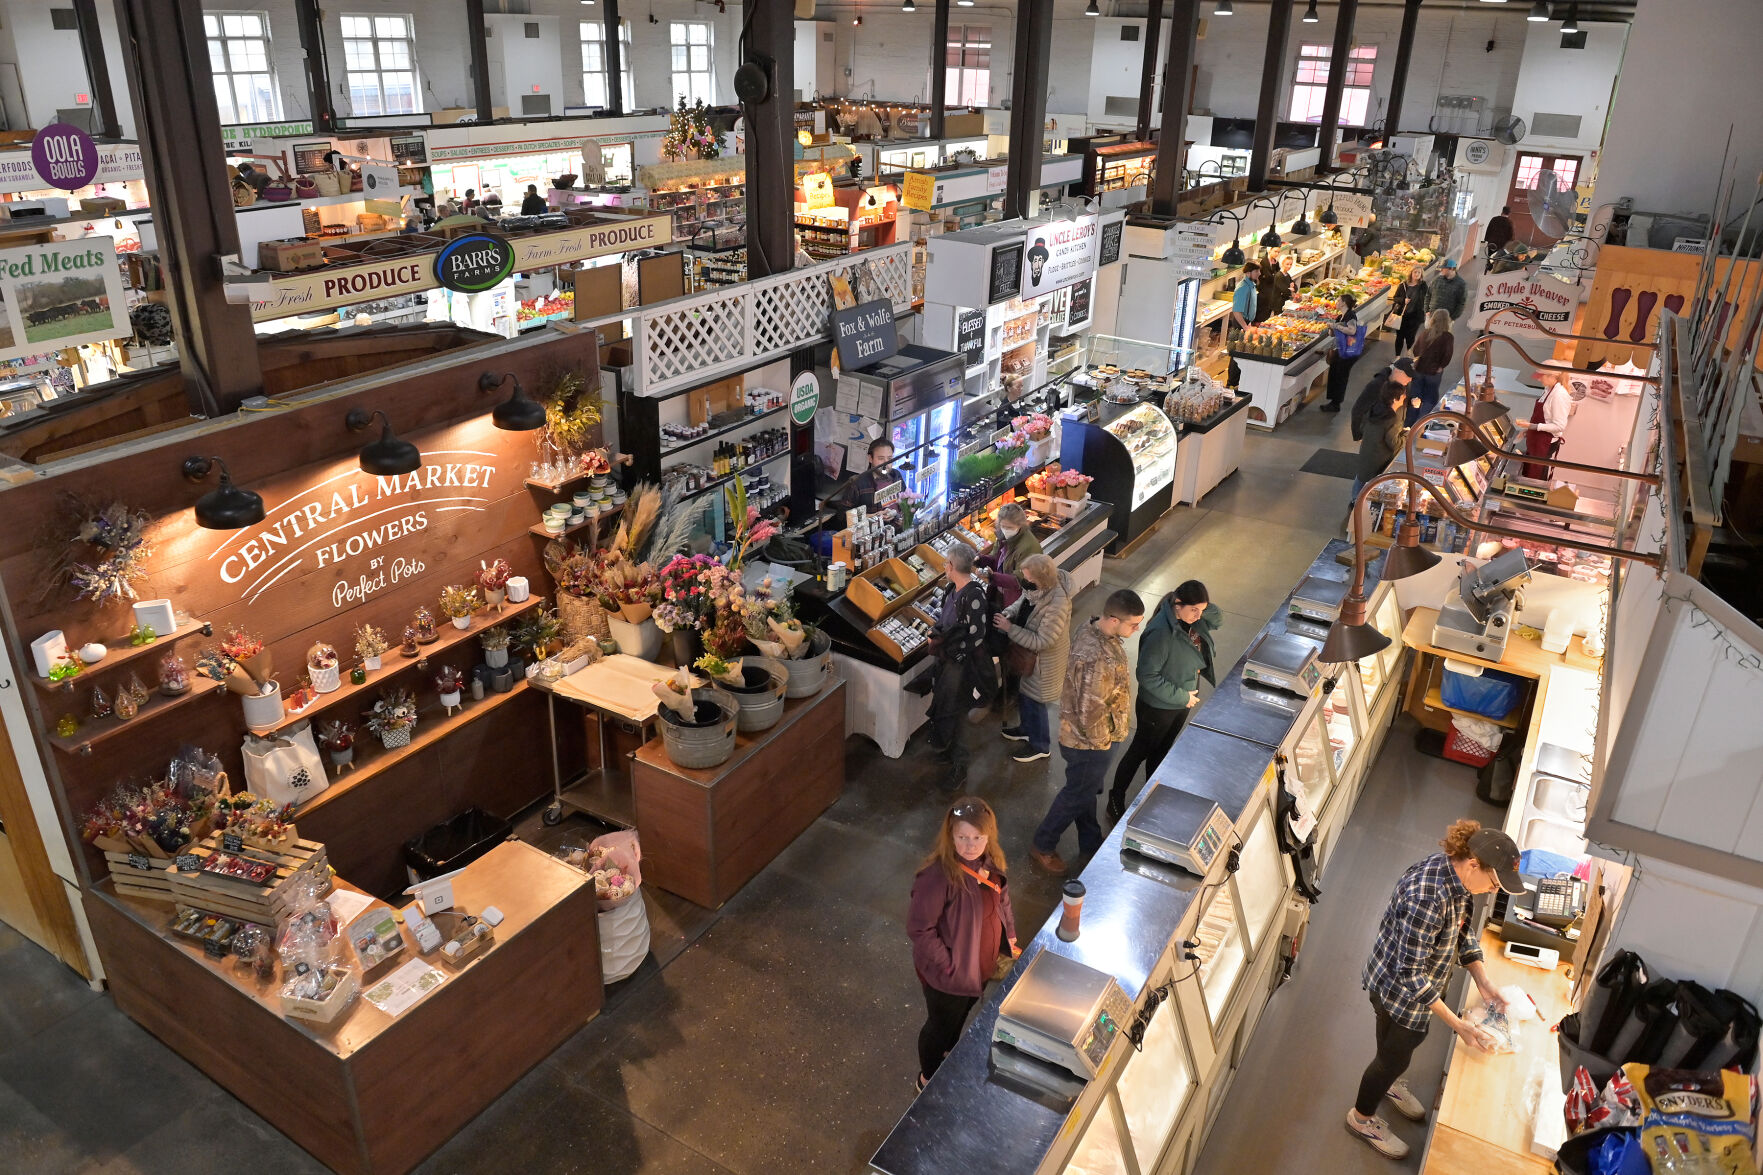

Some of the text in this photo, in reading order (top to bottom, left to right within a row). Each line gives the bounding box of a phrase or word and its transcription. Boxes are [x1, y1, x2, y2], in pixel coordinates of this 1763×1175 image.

[43, 134, 84, 163] OOLA
[450, 149, 468, 157] SALADS
[471, 147, 491, 155] ENTREES
[493, 144, 515, 153] DESSERTS
[100, 154, 118, 165] ACAI
[49, 161, 87, 180] BOWLS
[101, 165, 122, 174] ORGANIC
[908, 184, 928, 194] Family
[909, 176, 928, 186] Amish
[906, 191, 928, 201] Recipes
[589, 224, 655, 249] PRODUCE
[1049, 223, 1096, 247] UNCLE LEROY'S
[1056, 243, 1087, 257] CANDY KITCHEN
[0, 250, 105, 280] Fed Meats
[454, 265, 500, 280] FARMS
[271, 286, 313, 309] Fresh
[324, 264, 421, 298] PRODUCE
[1485, 282, 1570, 306] S. Clyde Weaver
[839, 308, 891, 337] Fox & Wolfe
[1539, 312, 1565, 321] CHEESE
[962, 317, 984, 334] BLESSED
[855, 337, 884, 358] Farm
[796, 383, 814, 398] USDA
[794, 397, 816, 413] ORGANIC
[219, 463, 496, 584] CENTRAL MARKET
[314, 511, 428, 569] FLOWERS
[370, 555, 385, 570] BY
[332, 557, 426, 608] Perfect Pots
[1659, 1095, 1723, 1110] SNYDER'S
